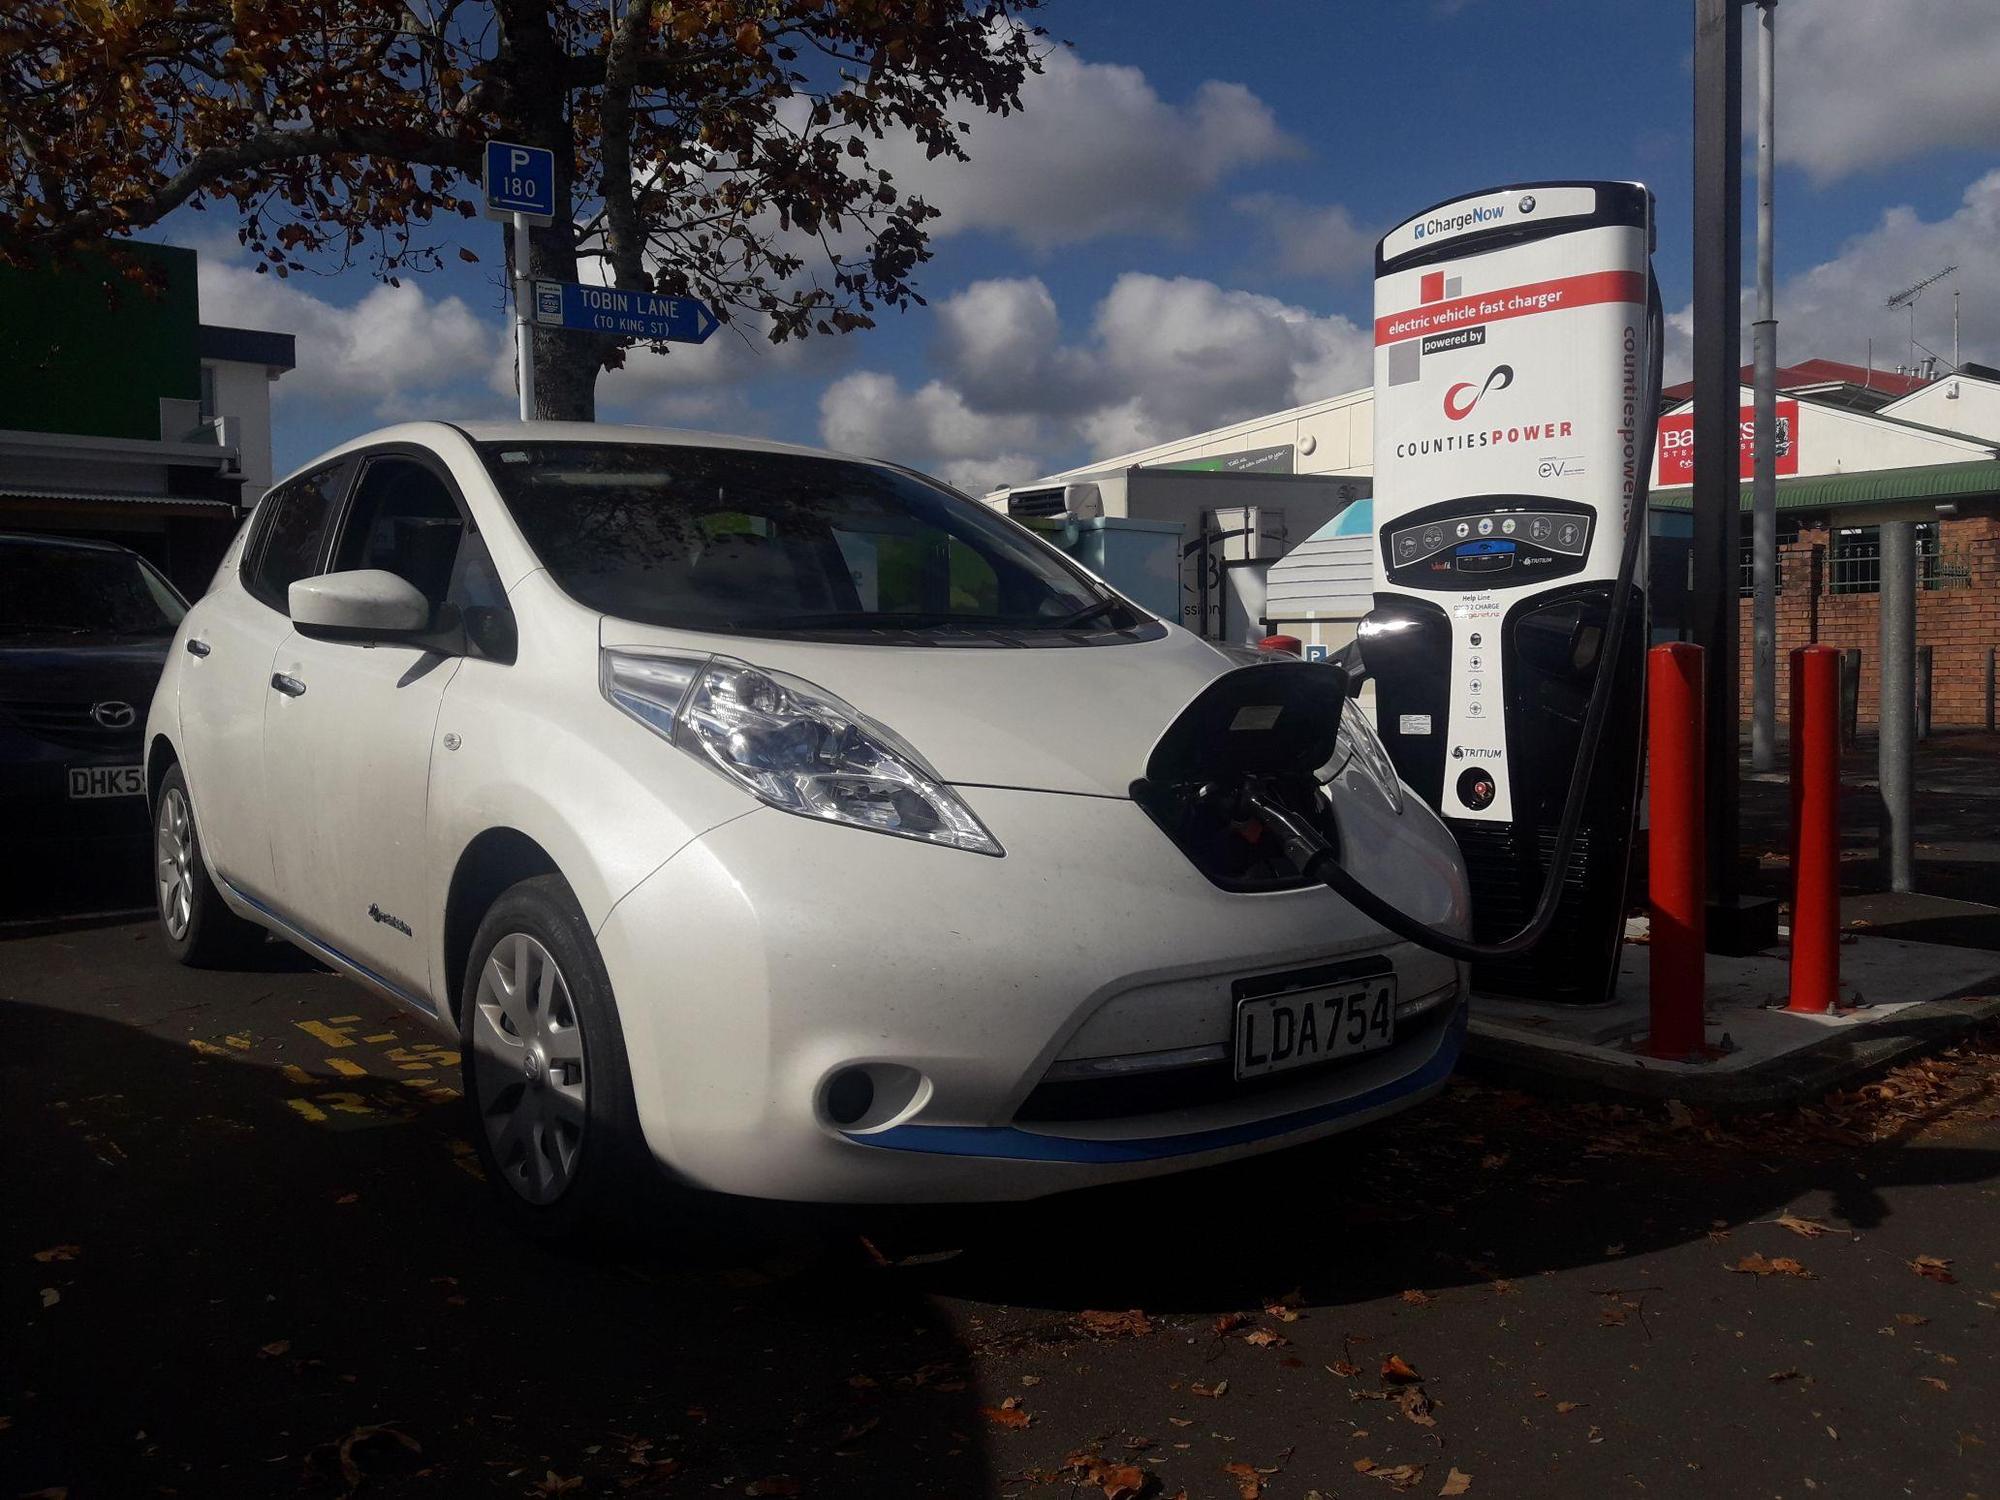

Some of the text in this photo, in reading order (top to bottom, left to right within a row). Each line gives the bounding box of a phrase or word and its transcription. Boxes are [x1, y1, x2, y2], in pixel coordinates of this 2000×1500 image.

[511, 149, 530, 173] P
[503, 177, 536, 198] 180
[1427, 204, 1504, 236] ChargeNow
[580, 289, 679, 319] TOBIN LANE
[1388, 289, 1562, 335] electric vehicle fast charger
[594, 315, 670, 337] (TO KING ST)
[1424, 329, 1483, 353] powered by
[1462, 594, 1476, 602] Help
[1475, 602, 1500, 610] CHARGE
[1310, 650, 1321, 661] P
[1463, 747, 1502, 759] TRITIUM
[71, 768, 147, 796] DHK5
[1244, 987, 1390, 1068] LDA754
